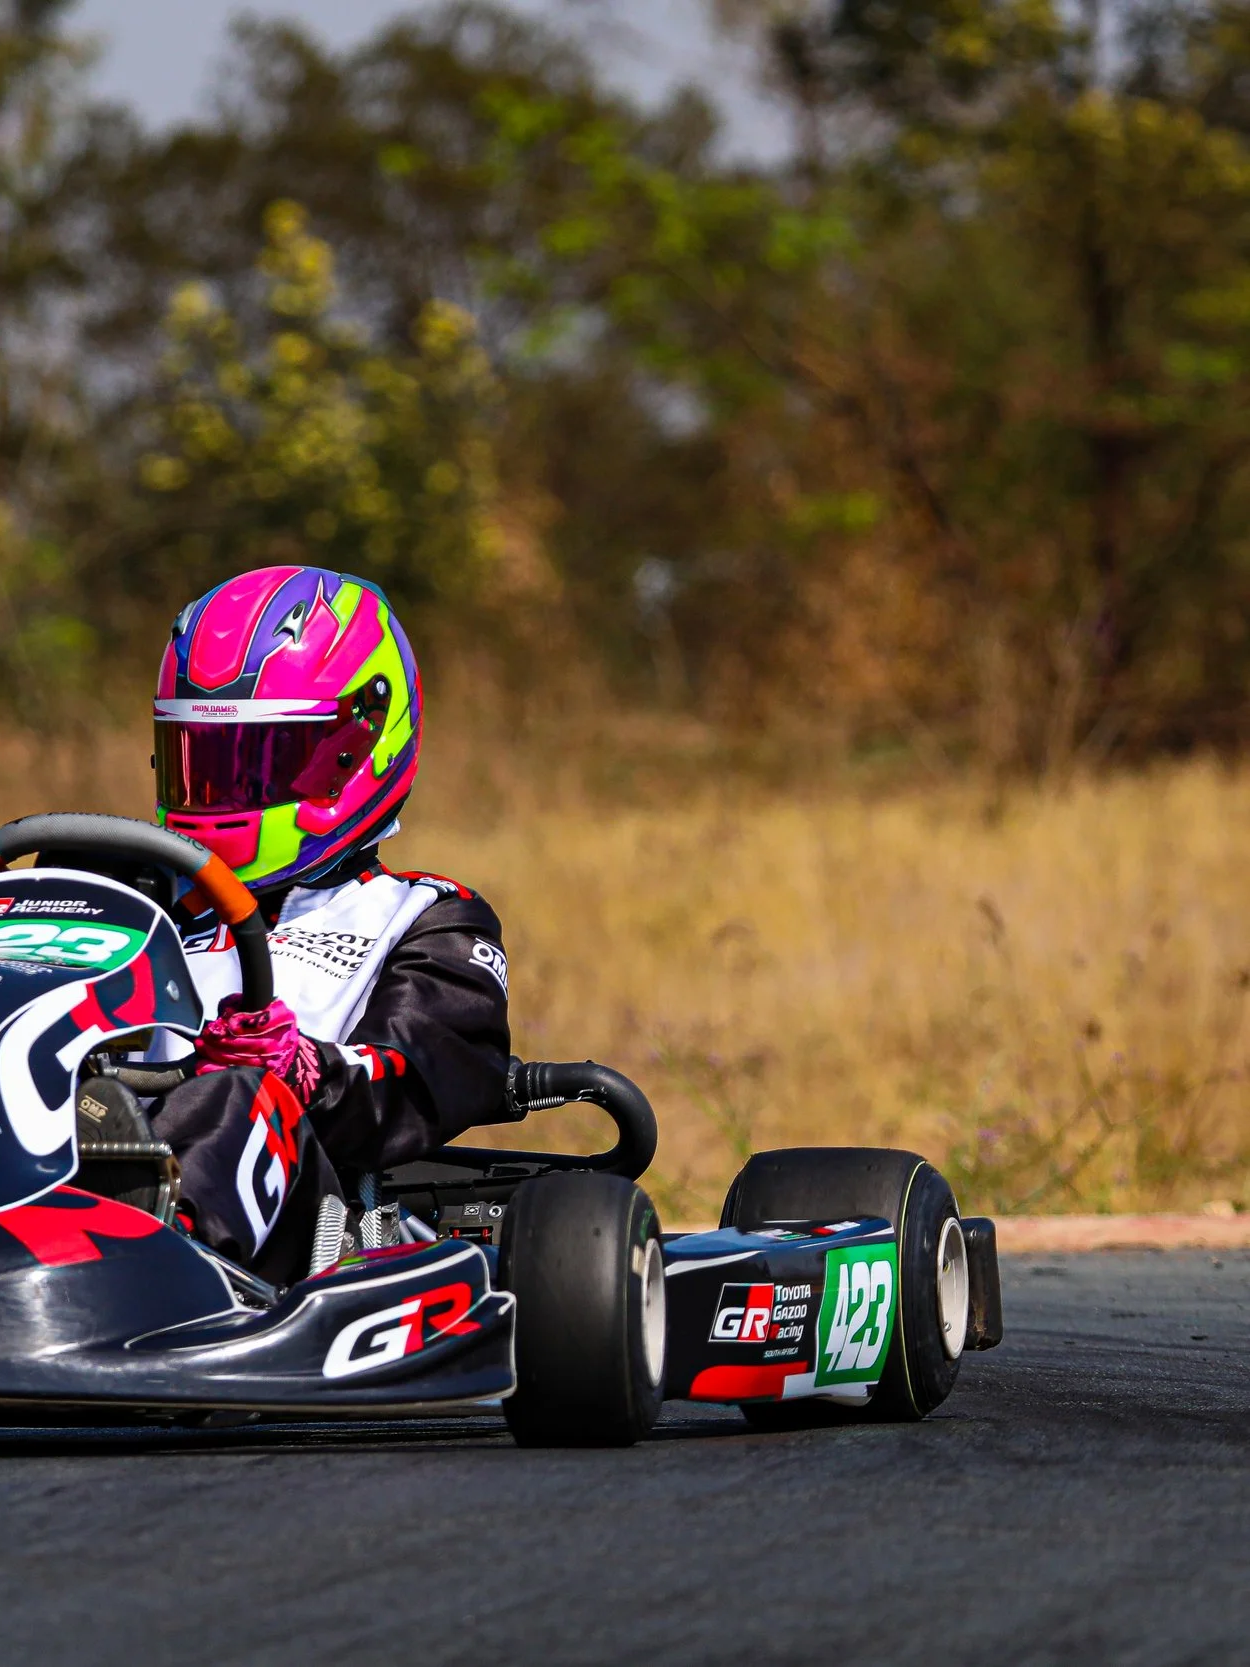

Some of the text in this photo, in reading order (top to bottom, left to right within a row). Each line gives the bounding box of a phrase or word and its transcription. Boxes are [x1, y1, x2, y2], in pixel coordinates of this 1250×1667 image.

[192, 704, 209, 713] IRON
[10, 905, 104, 916] ACADEMY
[14, 900, 87, 908] JUNIOR
[714, 1306, 770, 1339] GR
[825, 1261, 894, 1373] 423
[322, 1282, 481, 1378] GR
